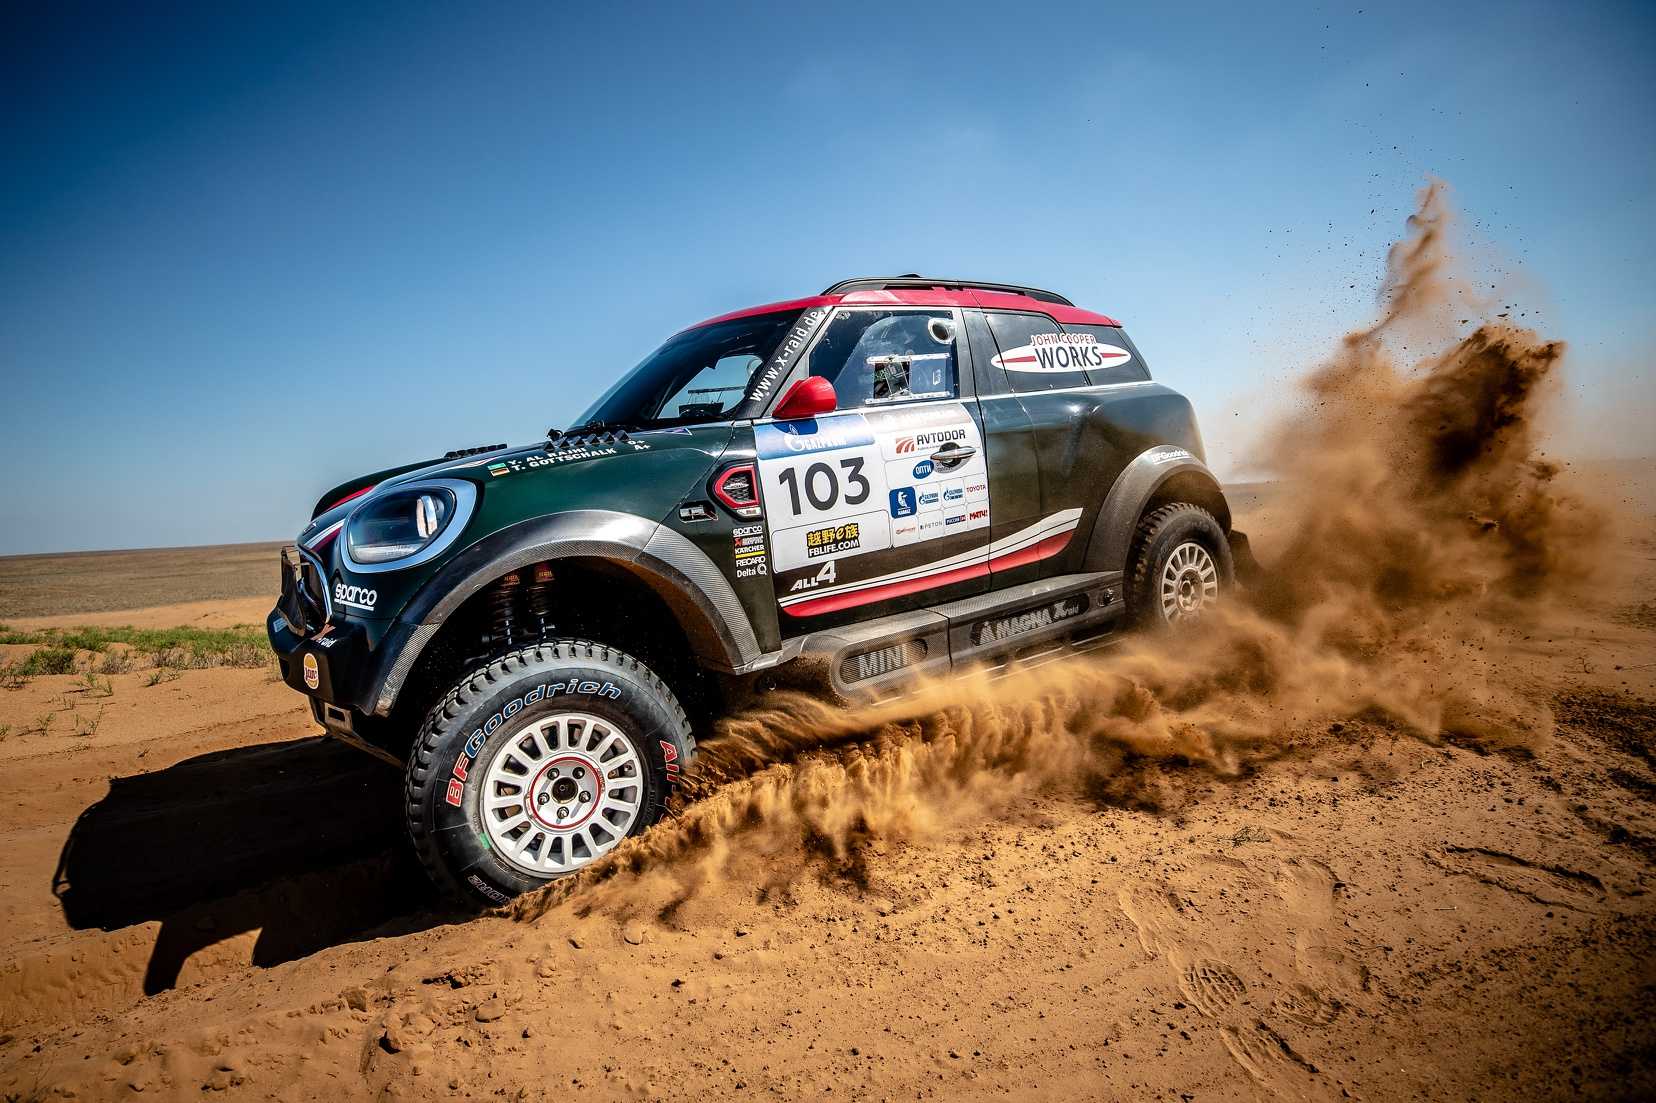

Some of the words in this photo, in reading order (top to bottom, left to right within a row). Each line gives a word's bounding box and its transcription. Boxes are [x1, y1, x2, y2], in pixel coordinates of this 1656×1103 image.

[1030, 334, 1060, 346] JOHN
[1061, 333, 1096, 345] COOPER
[750, 311, 819, 402] www.x-raid.de
[1035, 346, 1102, 368] WORKS
[917, 429, 966, 446] AVTODOR
[529, 447, 617, 468] GOTTSCHALK
[778, 456, 871, 516] 103
[966, 485, 987, 493] TOYOTA
[733, 525, 763, 536] sparco
[809, 539, 859, 557] FBLIFE.COM
[736, 556, 766, 567] RECARO
[335, 583, 377, 606] sparco
[858, 643, 908, 678] MINI
[446, 679, 622, 807] BFGoodrich
